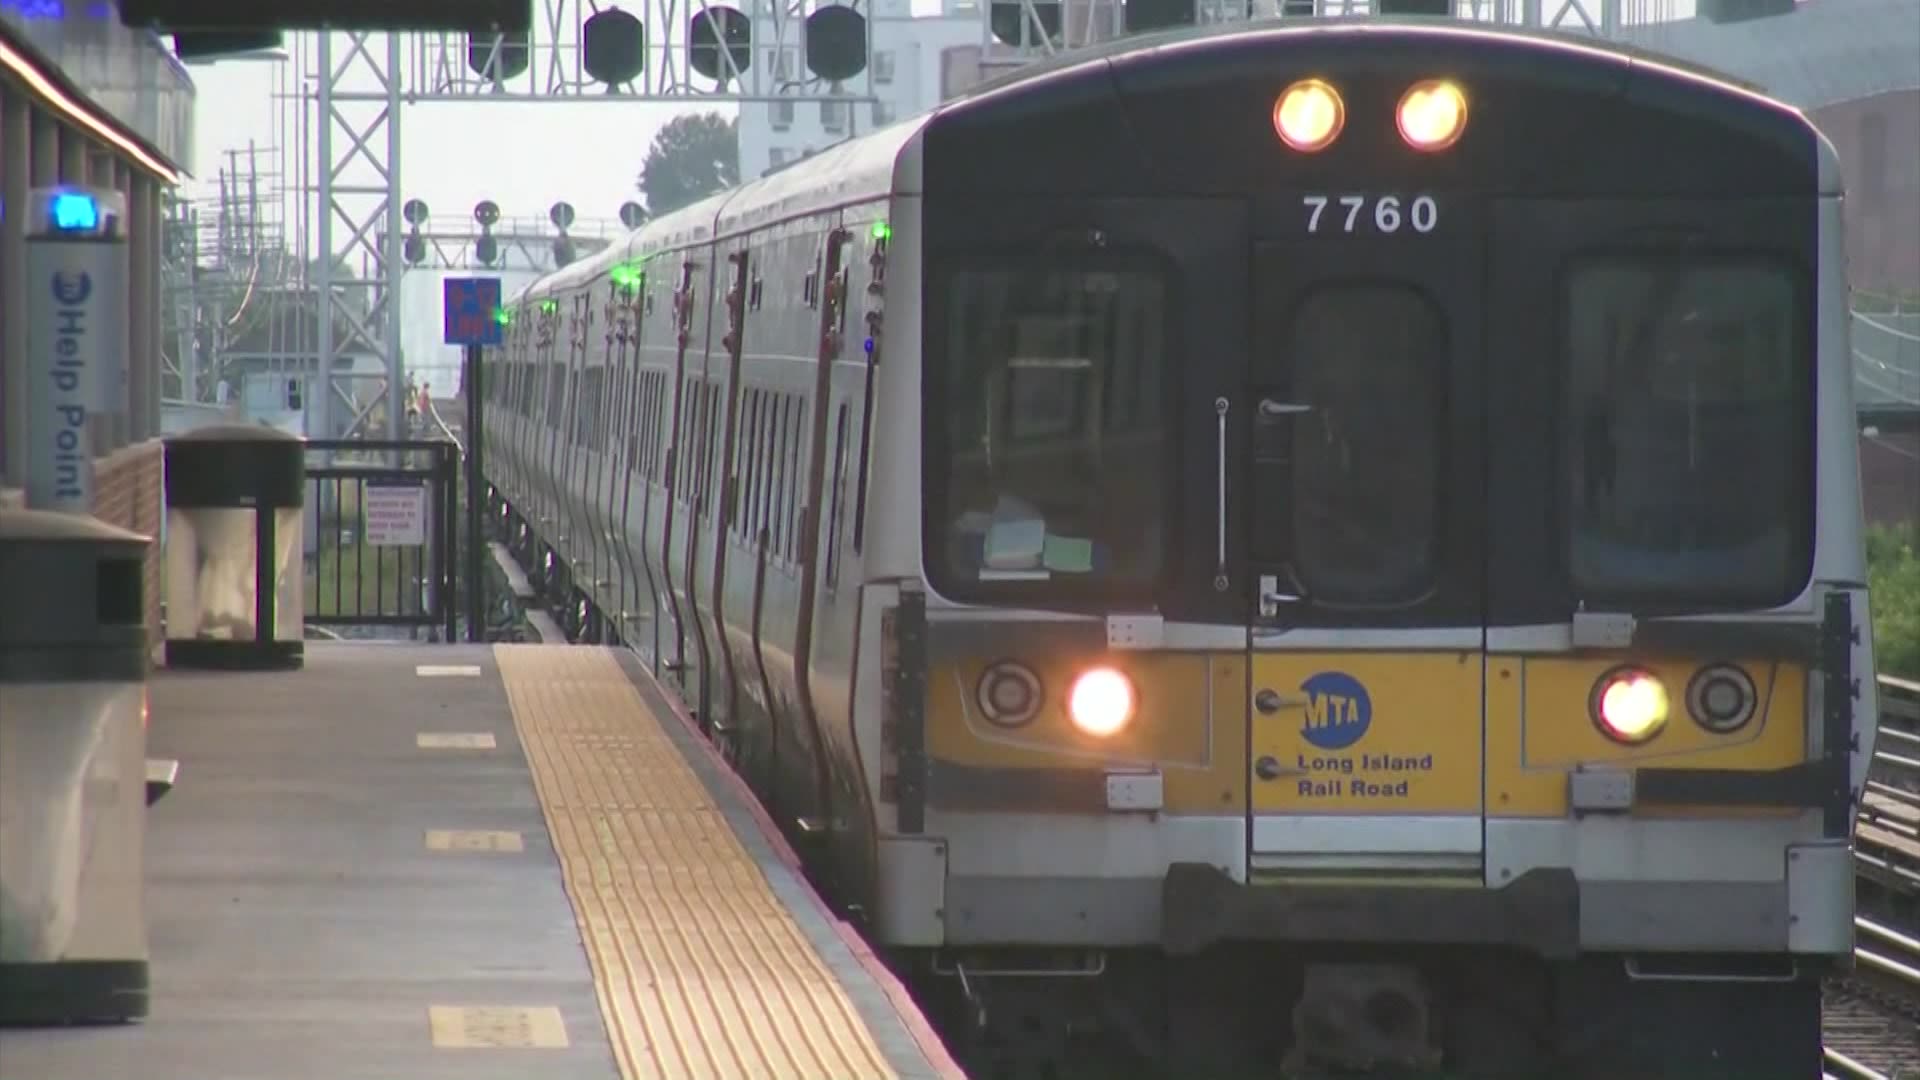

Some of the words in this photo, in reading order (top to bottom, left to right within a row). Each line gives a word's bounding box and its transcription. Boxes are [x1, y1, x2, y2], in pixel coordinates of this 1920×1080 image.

[1303, 195, 1438, 233] 7760
[49, 310, 85, 392] Help
[55, 405, 85, 498] Point
[1300, 690, 1360, 730] MTA
[1297, 754, 1354, 774] Long
[1361, 754, 1433, 771] Island
[1297, 780, 1342, 797] Rail
[1351, 780, 1409, 797] Road
